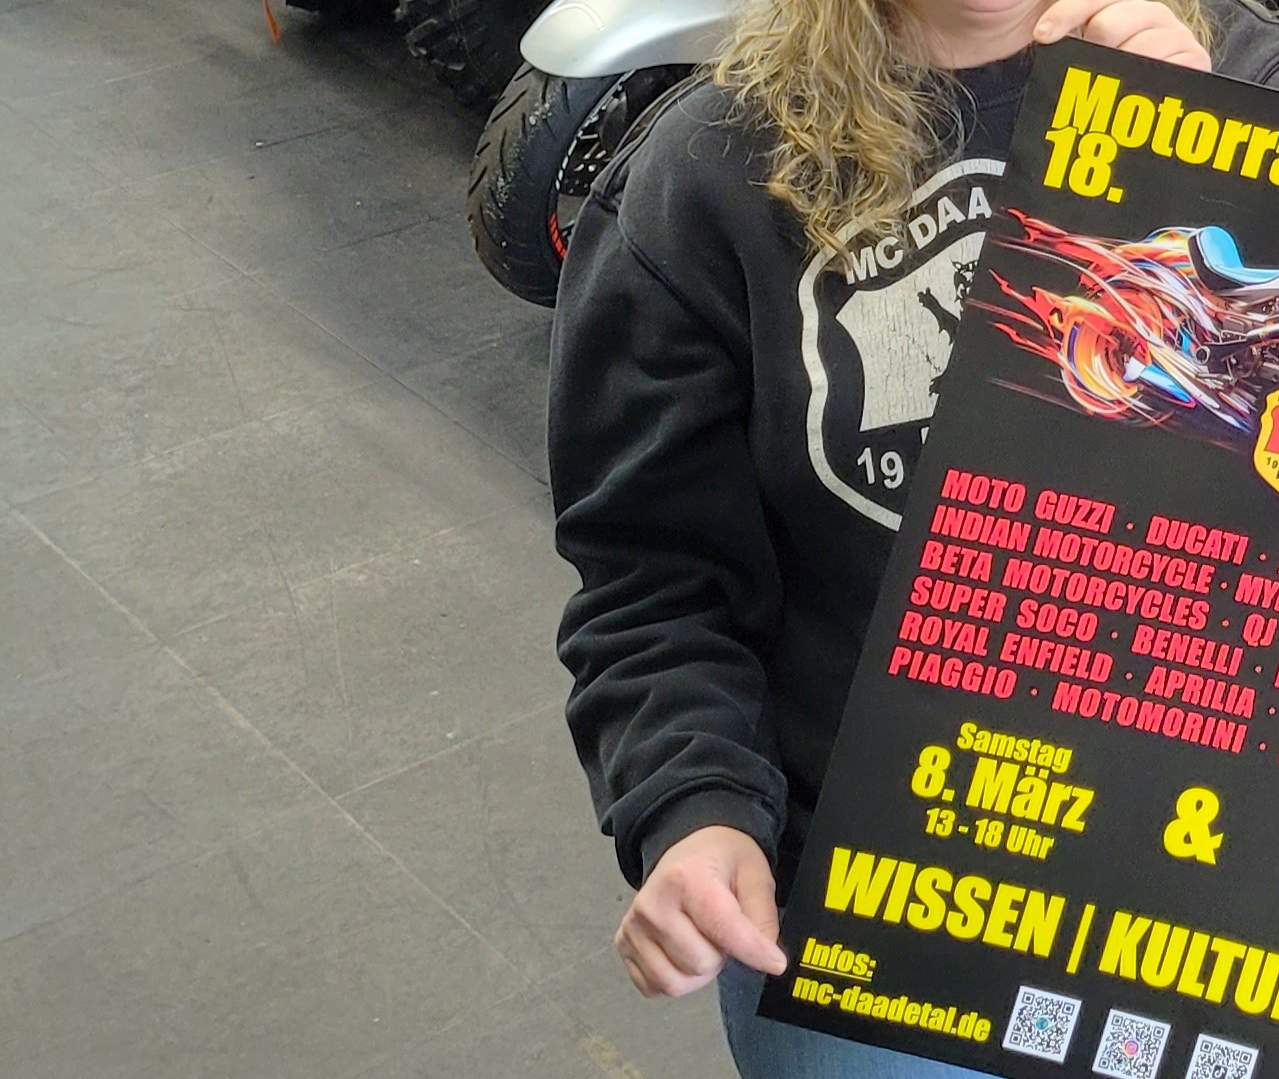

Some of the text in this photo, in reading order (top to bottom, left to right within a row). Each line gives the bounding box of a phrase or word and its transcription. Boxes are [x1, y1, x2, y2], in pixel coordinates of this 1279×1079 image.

[1042, 124, 1126, 204] 18.
[846, 235, 905, 286] MC
[856, 446, 905, 490] 19
[930, 504, 1032, 552] INDIAN
[1032, 527, 1216, 594] MOTORCYCLE
[940, 468, 1027, 513] MOTO
[1035, 490, 1116, 534] GUZZI
[1145, 516, 1249, 564] DUCATI
[910, 575, 1009, 623] SUPER
[1015, 597, 1099, 643] SOCO
[1131, 624, 1245, 677] BENELLI
[919, 539, 994, 583] BETA
[1001, 558, 1211, 630] MOTORCYCLES
[1241, 612, 1278, 648] QJ
[888, 646, 1019, 699] PIAGGIO
[1051, 681, 1249, 754] MOTOMORINI
[899, 610, 990, 657] ROYAL
[999, 632, 1115, 683] ENFIELD
[1143, 665, 1257, 719] APRILIA
[910, 745, 1096, 834] 8. März
[956, 722, 1074, 774] Samstag
[925, 807, 957, 839] 13
[973, 817, 1004, 850] 18
[1005, 824, 1055, 861] Uhr
[1163, 785, 1225, 866] &
[824, 846, 1066, 959] WISSEN
[801, 937, 877, 982] Infos:
[792, 976, 992, 1043] mc-daadetal.de
